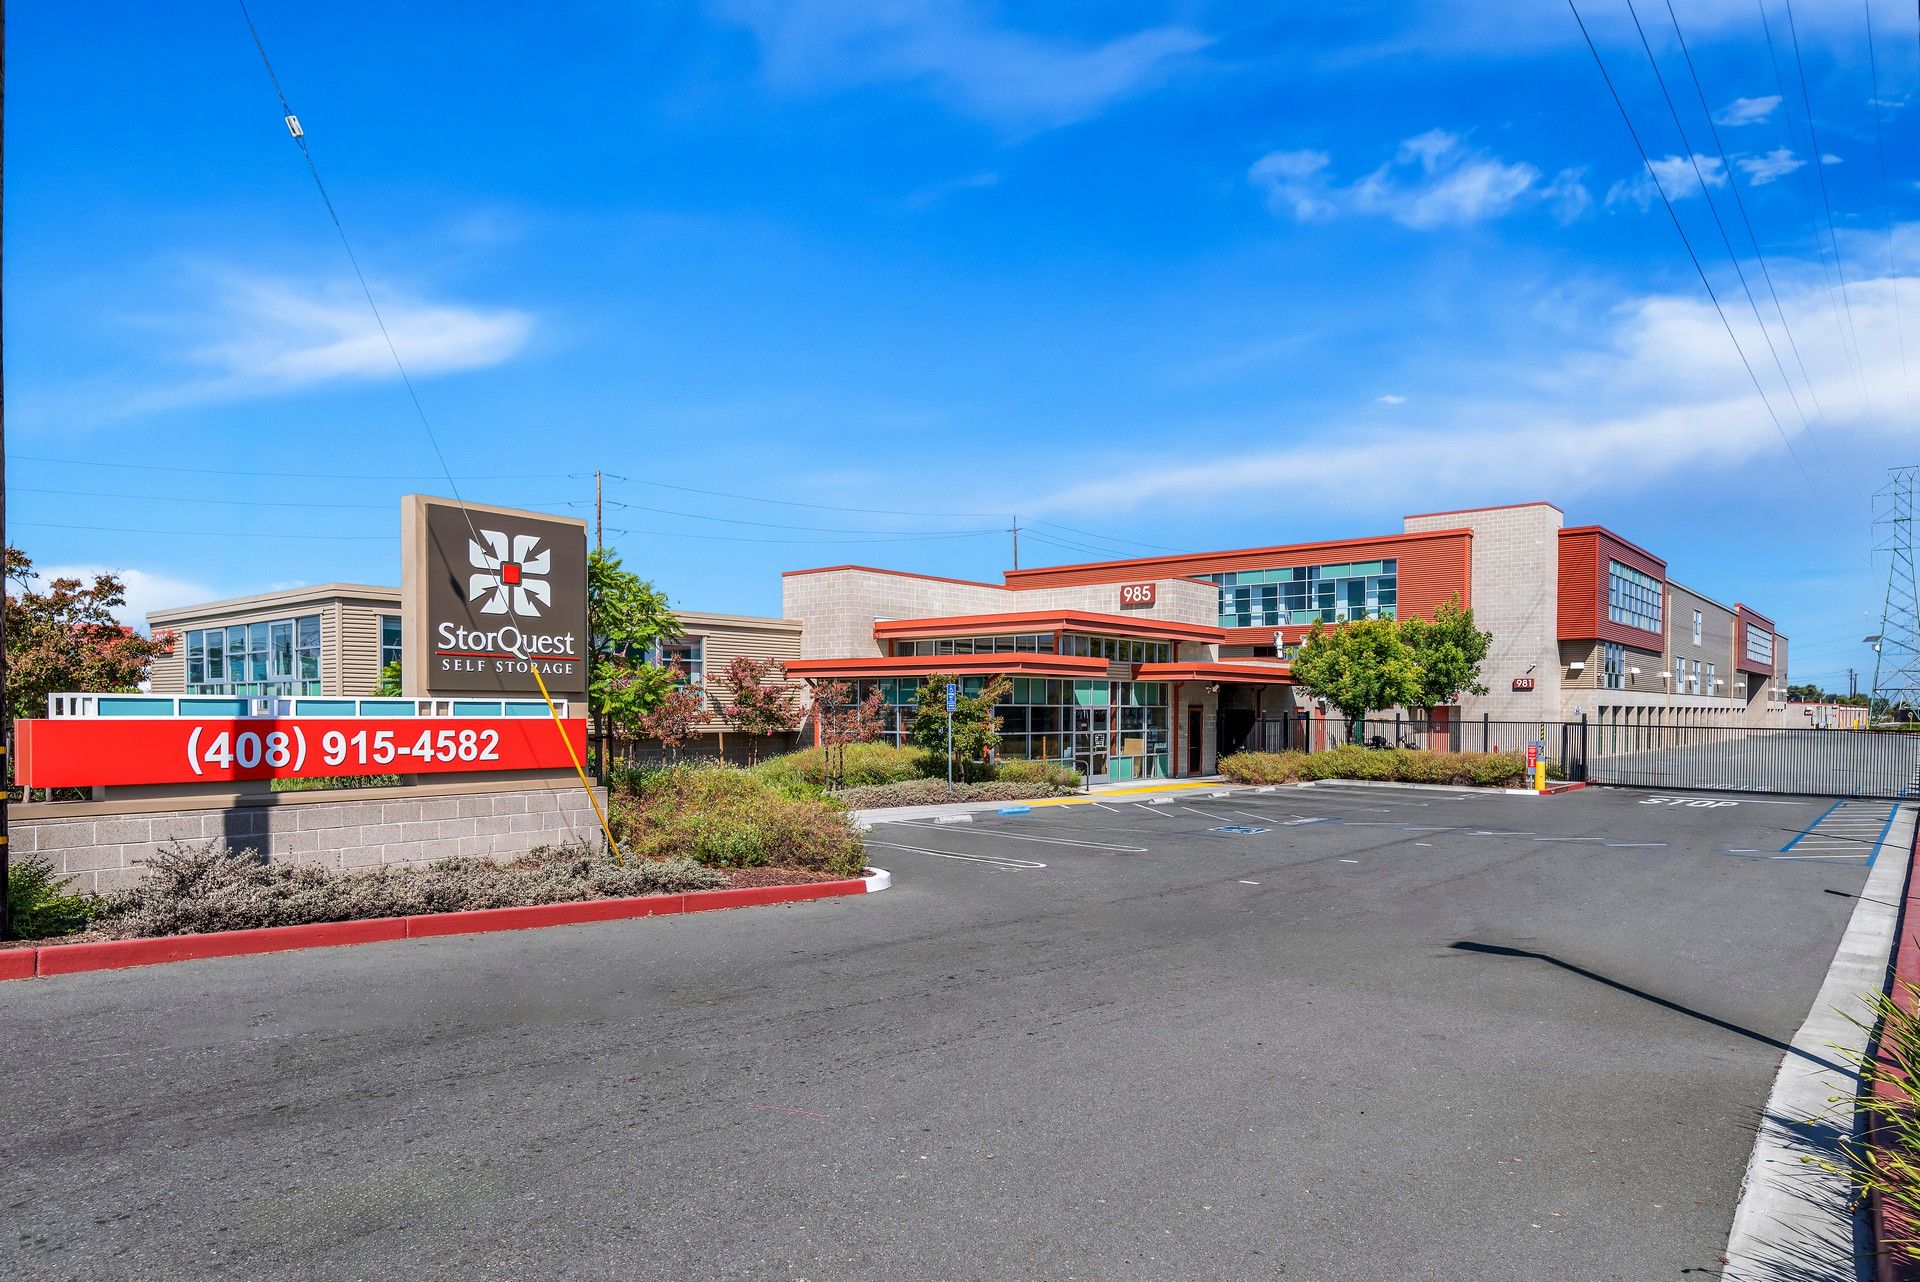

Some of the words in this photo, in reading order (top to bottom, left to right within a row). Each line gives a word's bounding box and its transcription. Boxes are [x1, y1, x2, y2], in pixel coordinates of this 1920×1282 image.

[1123, 585, 1151, 602] 985
[437, 621, 575, 660] StorQuest
[442, 658, 485, 672] SELF
[496, 660, 573, 675] STORAGE
[1516, 679, 1532, 688] 981
[187, 726, 307, 775] (408)
[322, 729, 500, 766] 915-4582
[1639, 798, 1739, 808] STOP
